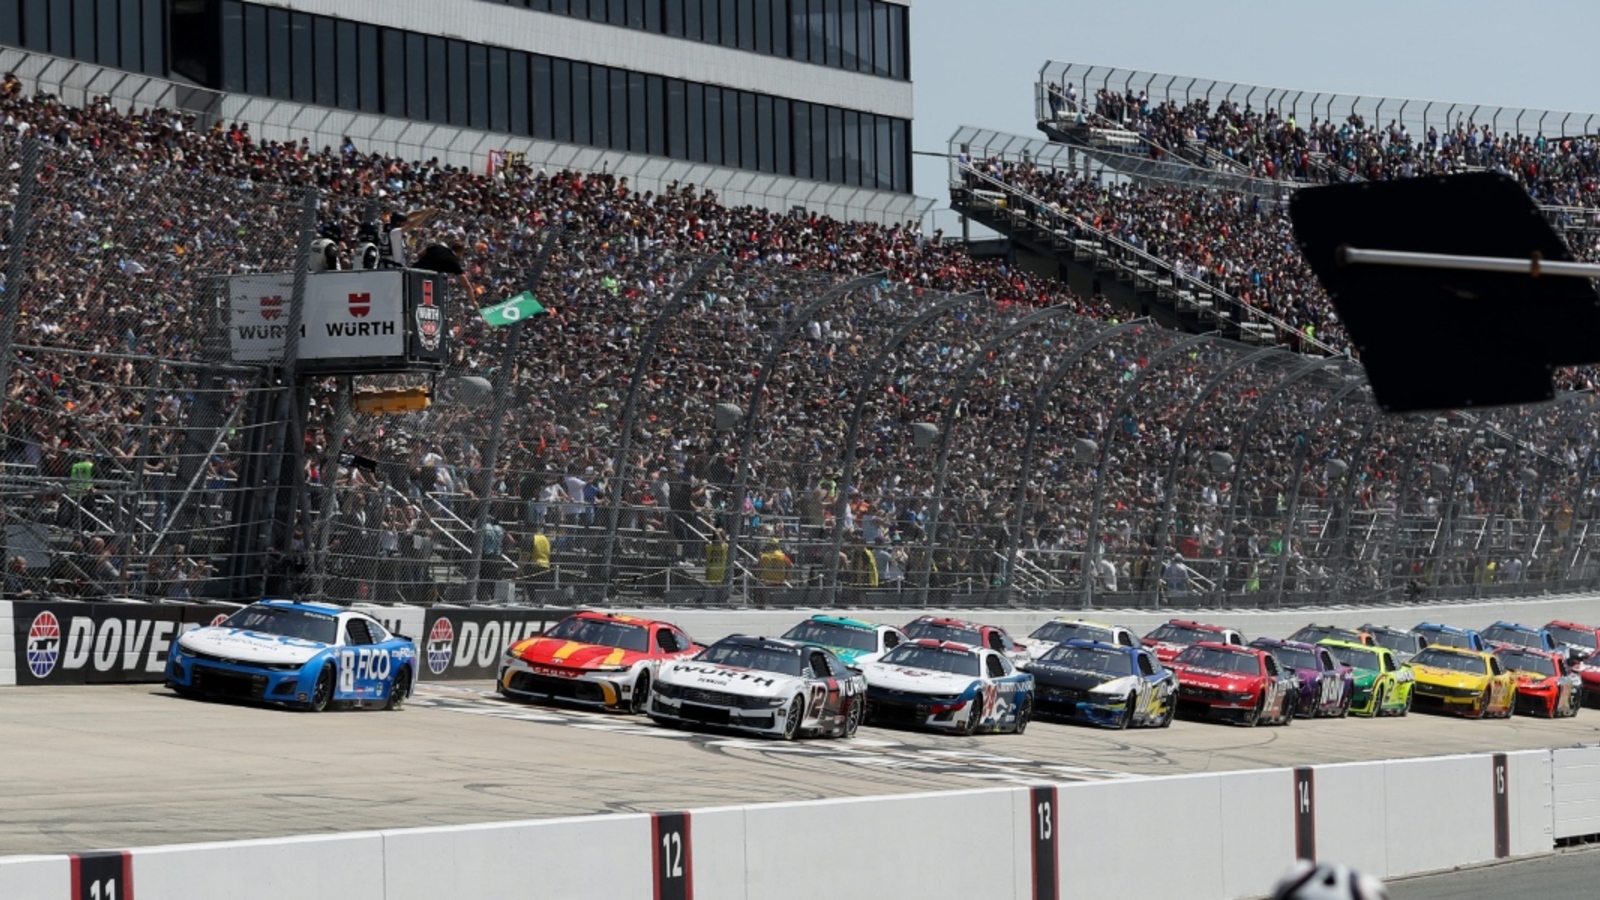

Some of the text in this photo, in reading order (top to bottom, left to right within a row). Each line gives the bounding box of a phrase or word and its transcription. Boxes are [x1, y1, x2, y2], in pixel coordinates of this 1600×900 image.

[325, 320, 395, 337] WÜRTH
[62, 616, 199, 672] DOVE
[453, 620, 560, 668] DOV
[340, 650, 355, 693] 8
[356, 648, 391, 681] FICO
[1298, 780, 1310, 814] 14
[1496, 765, 1505, 795] 15
[1037, 801, 1052, 840] 13
[662, 830, 683, 879] 12
